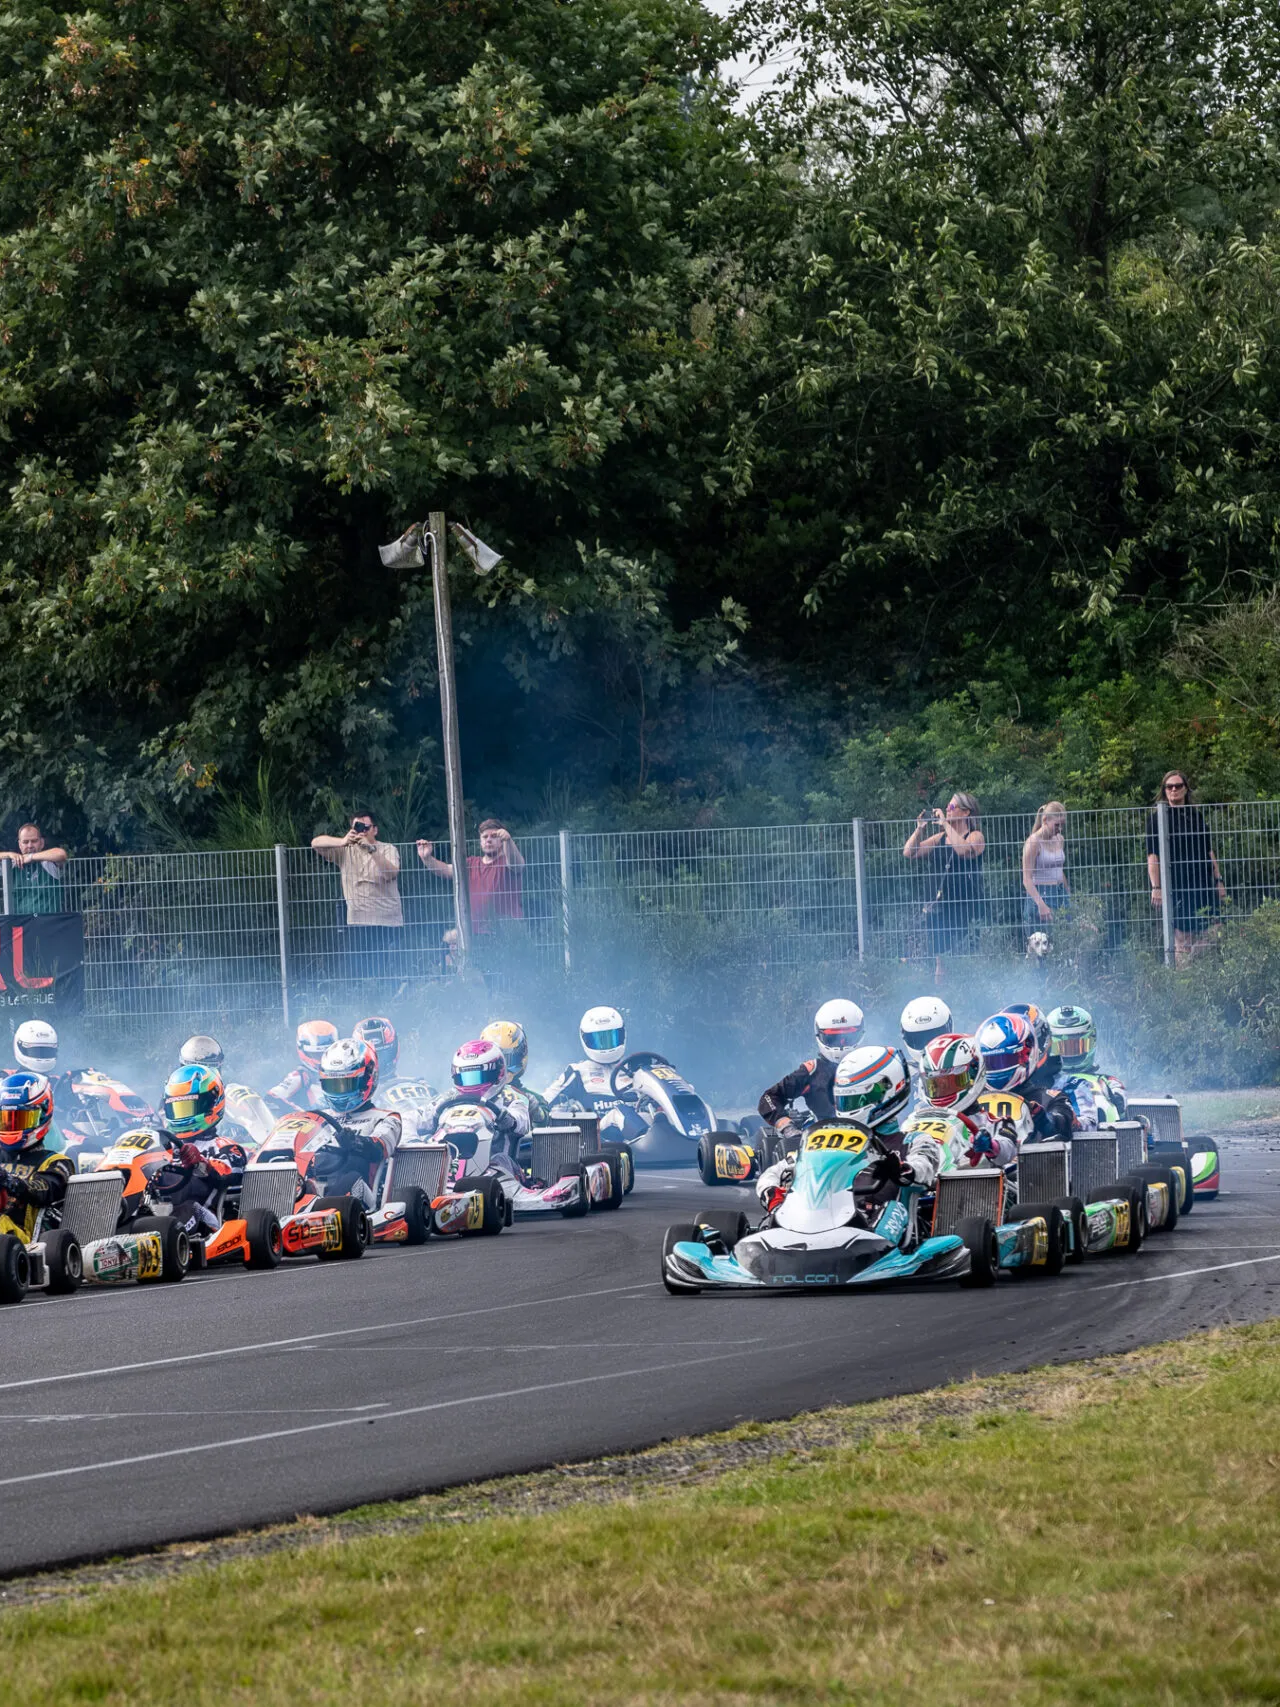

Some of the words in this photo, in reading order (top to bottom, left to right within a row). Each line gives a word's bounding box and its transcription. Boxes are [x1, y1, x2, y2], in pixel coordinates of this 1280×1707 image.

[808, 1133, 863, 1153] 302
[215, 1234, 243, 1254] SODI
[772, 1274, 840, 1284] FALCON
